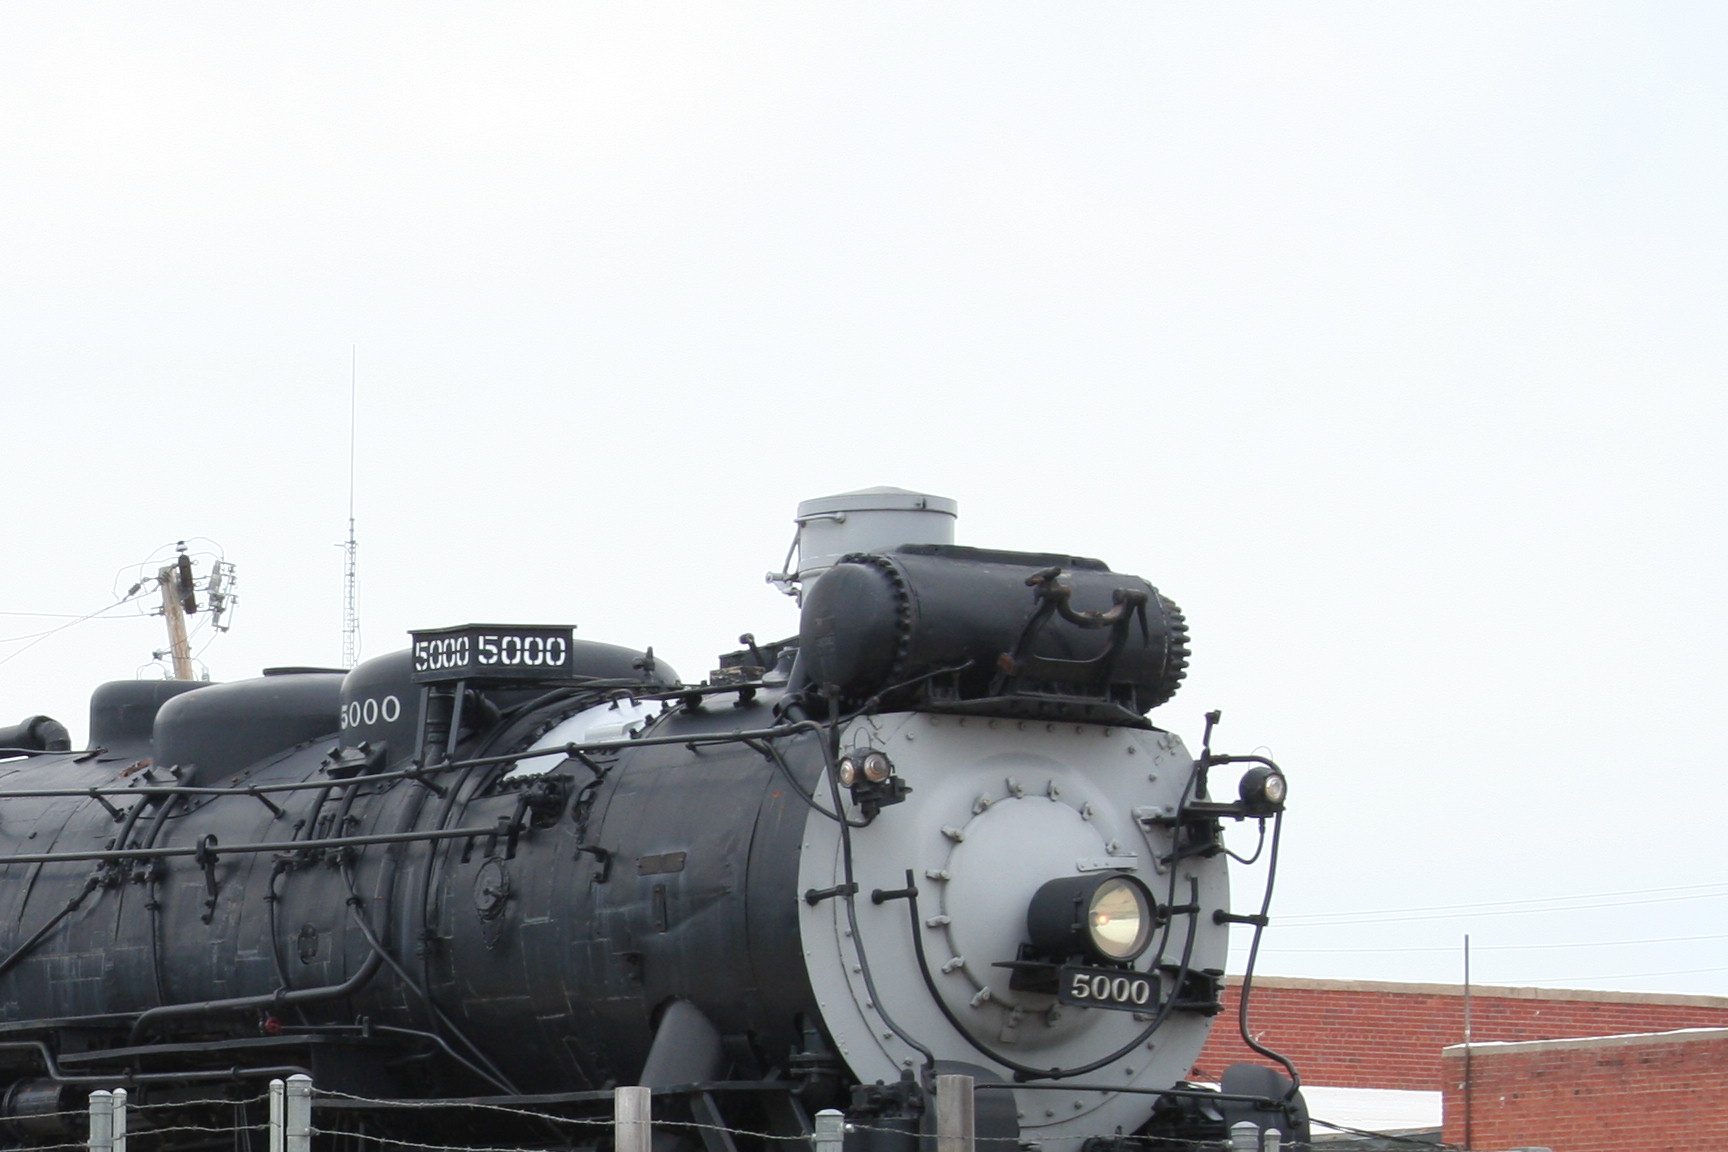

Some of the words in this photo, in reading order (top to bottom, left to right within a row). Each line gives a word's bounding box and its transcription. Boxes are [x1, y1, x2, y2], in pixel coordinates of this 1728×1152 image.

[415, 636, 470, 671] 5000
[478, 635, 566, 666] 5000
[340, 695, 401, 730] 5000
[1072, 974, 1150, 1005] 5000
